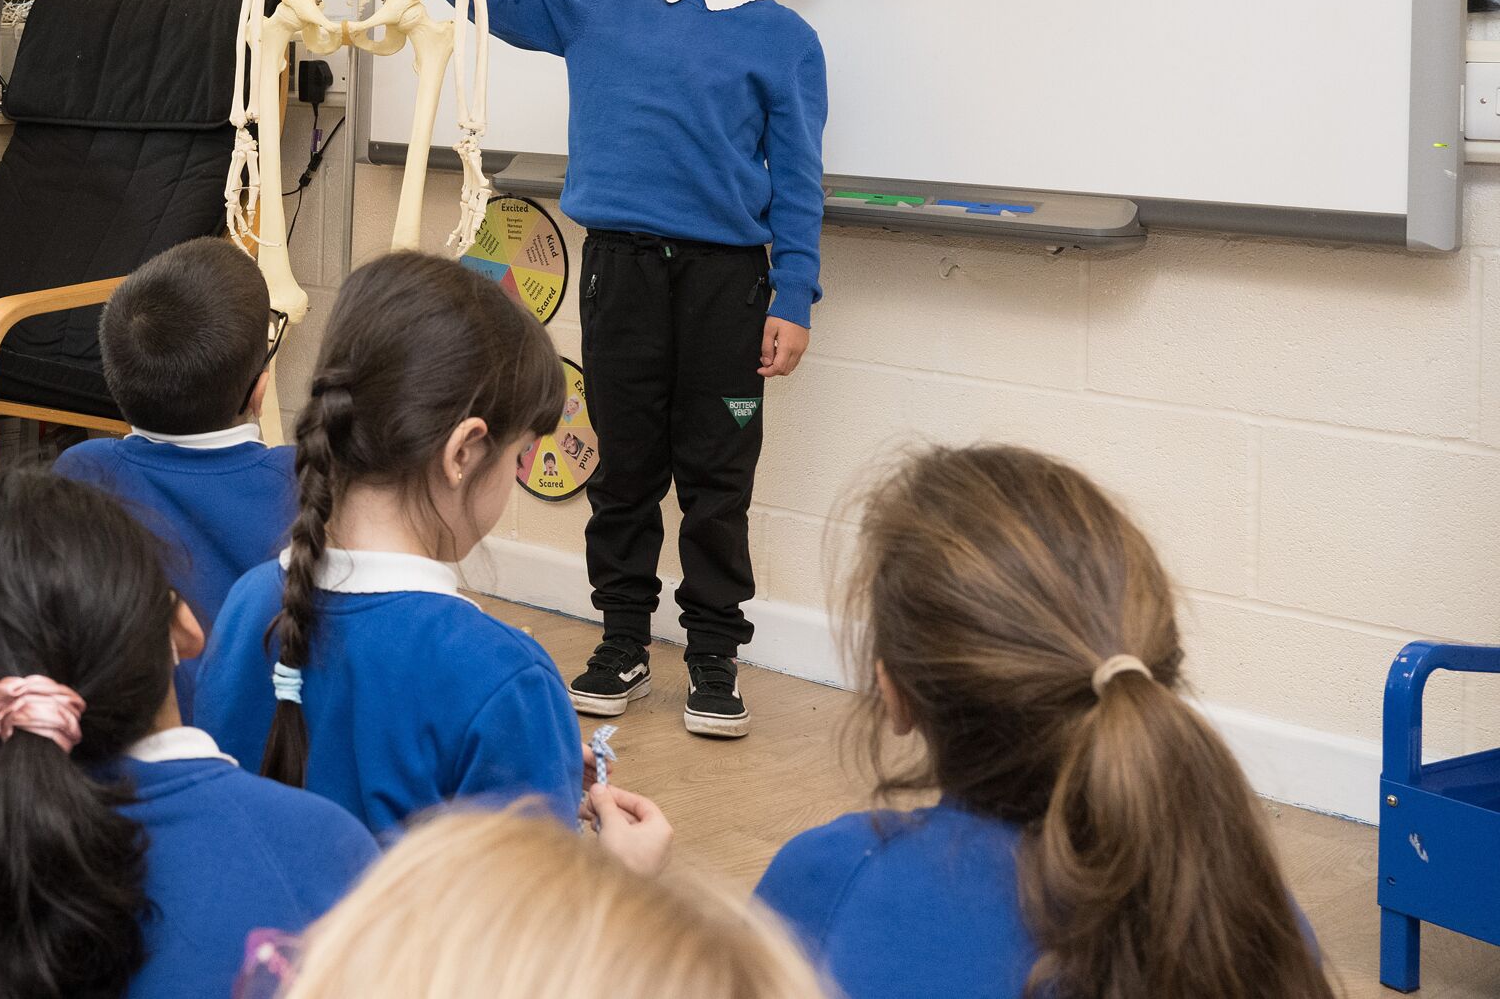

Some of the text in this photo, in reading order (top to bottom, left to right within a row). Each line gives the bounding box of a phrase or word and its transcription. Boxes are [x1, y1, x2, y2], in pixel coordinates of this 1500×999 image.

[501, 203, 529, 212] Excited
[546, 234, 560, 258] Kind
[536, 287, 557, 316] Scared
[579, 446, 595, 470] Kind
[538, 479, 564, 488] Scared
